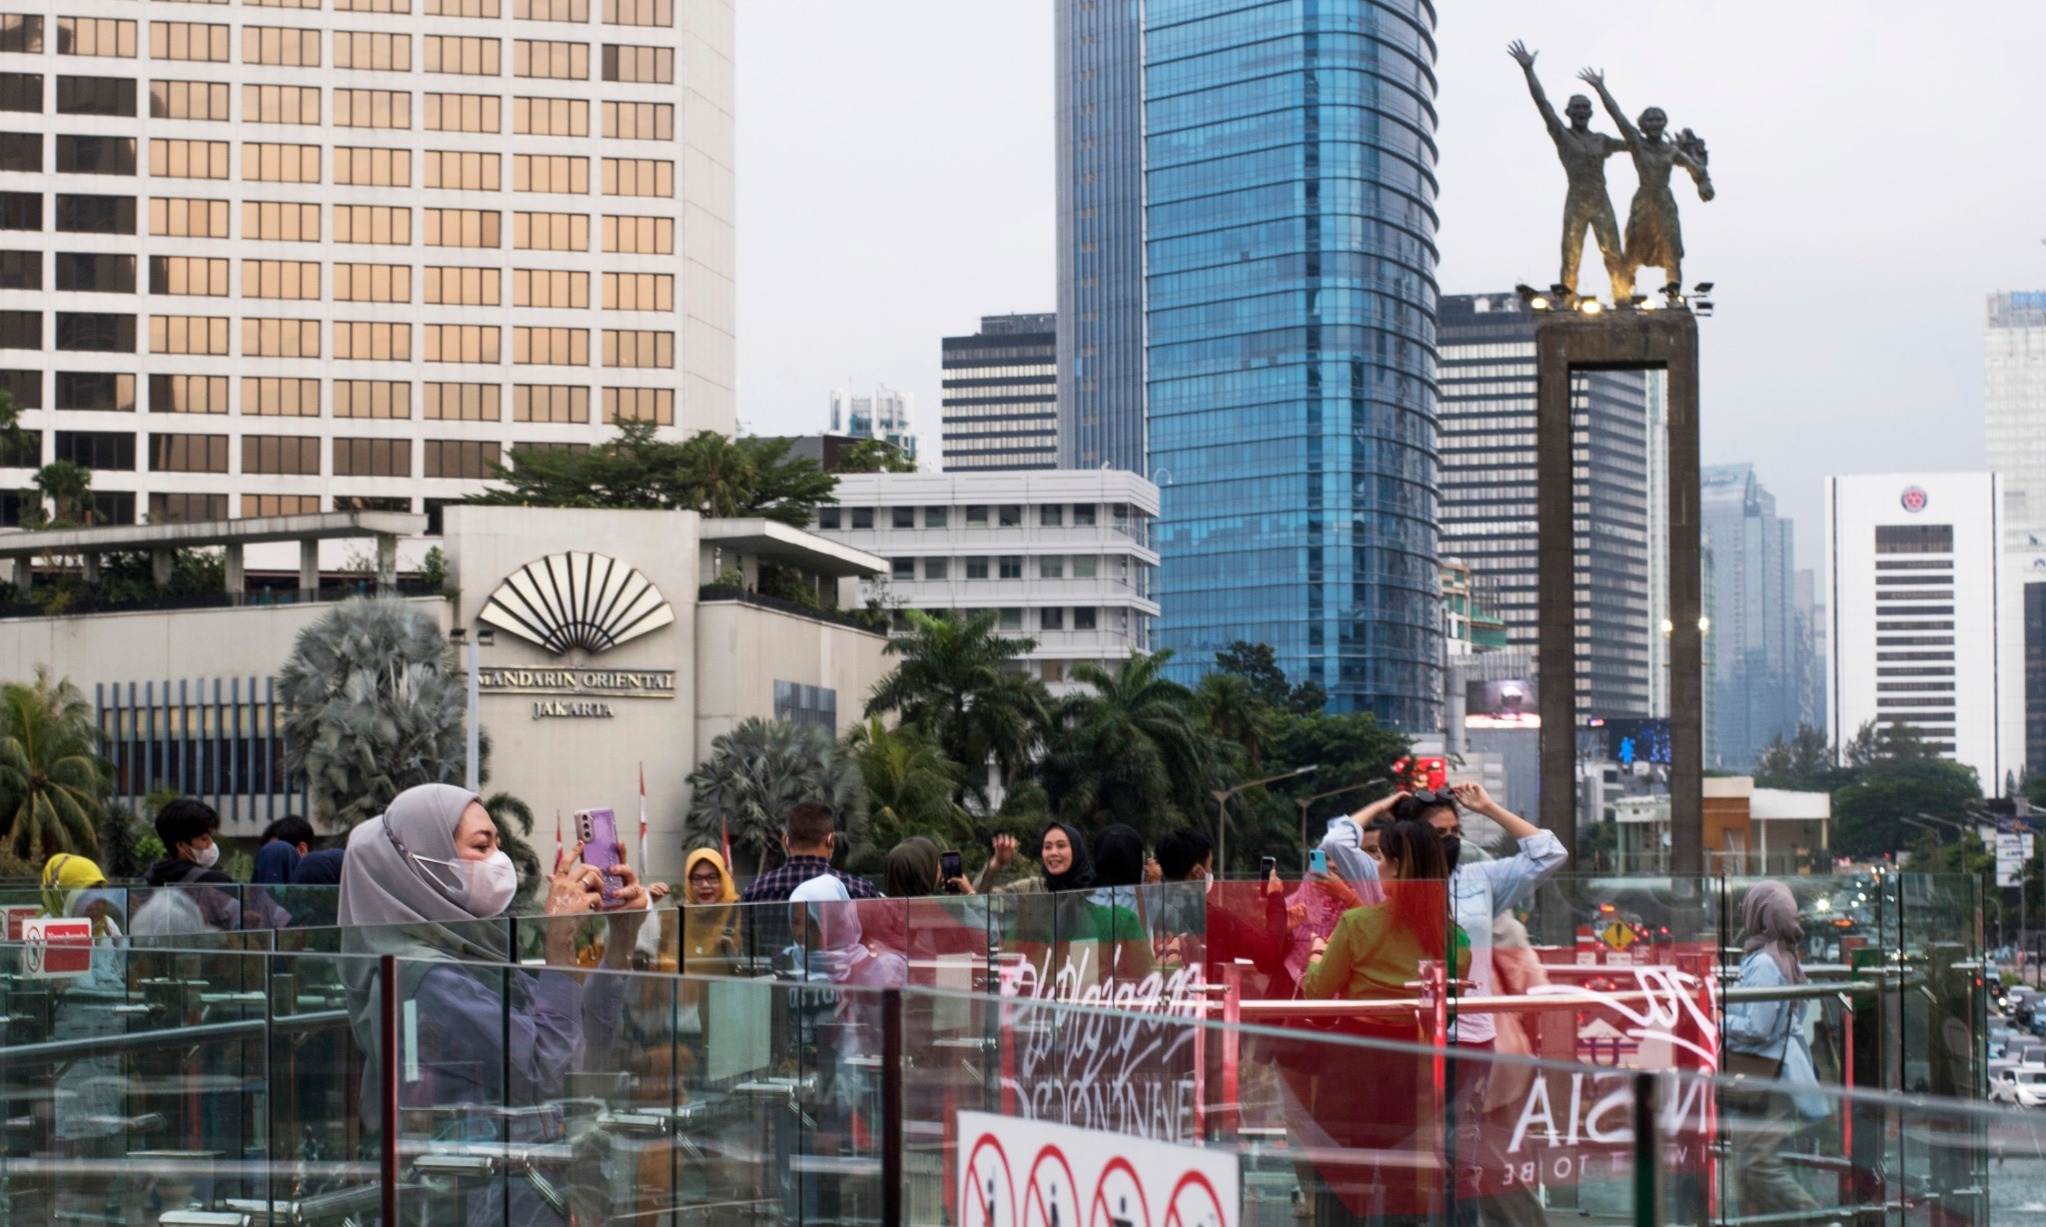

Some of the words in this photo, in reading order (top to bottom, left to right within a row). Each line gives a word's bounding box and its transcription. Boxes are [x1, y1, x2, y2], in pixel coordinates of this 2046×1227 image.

[478, 669, 577, 689] MANDARIN
[582, 672, 675, 690] ORIENTAL
[533, 701, 615, 720] JAKARTA
